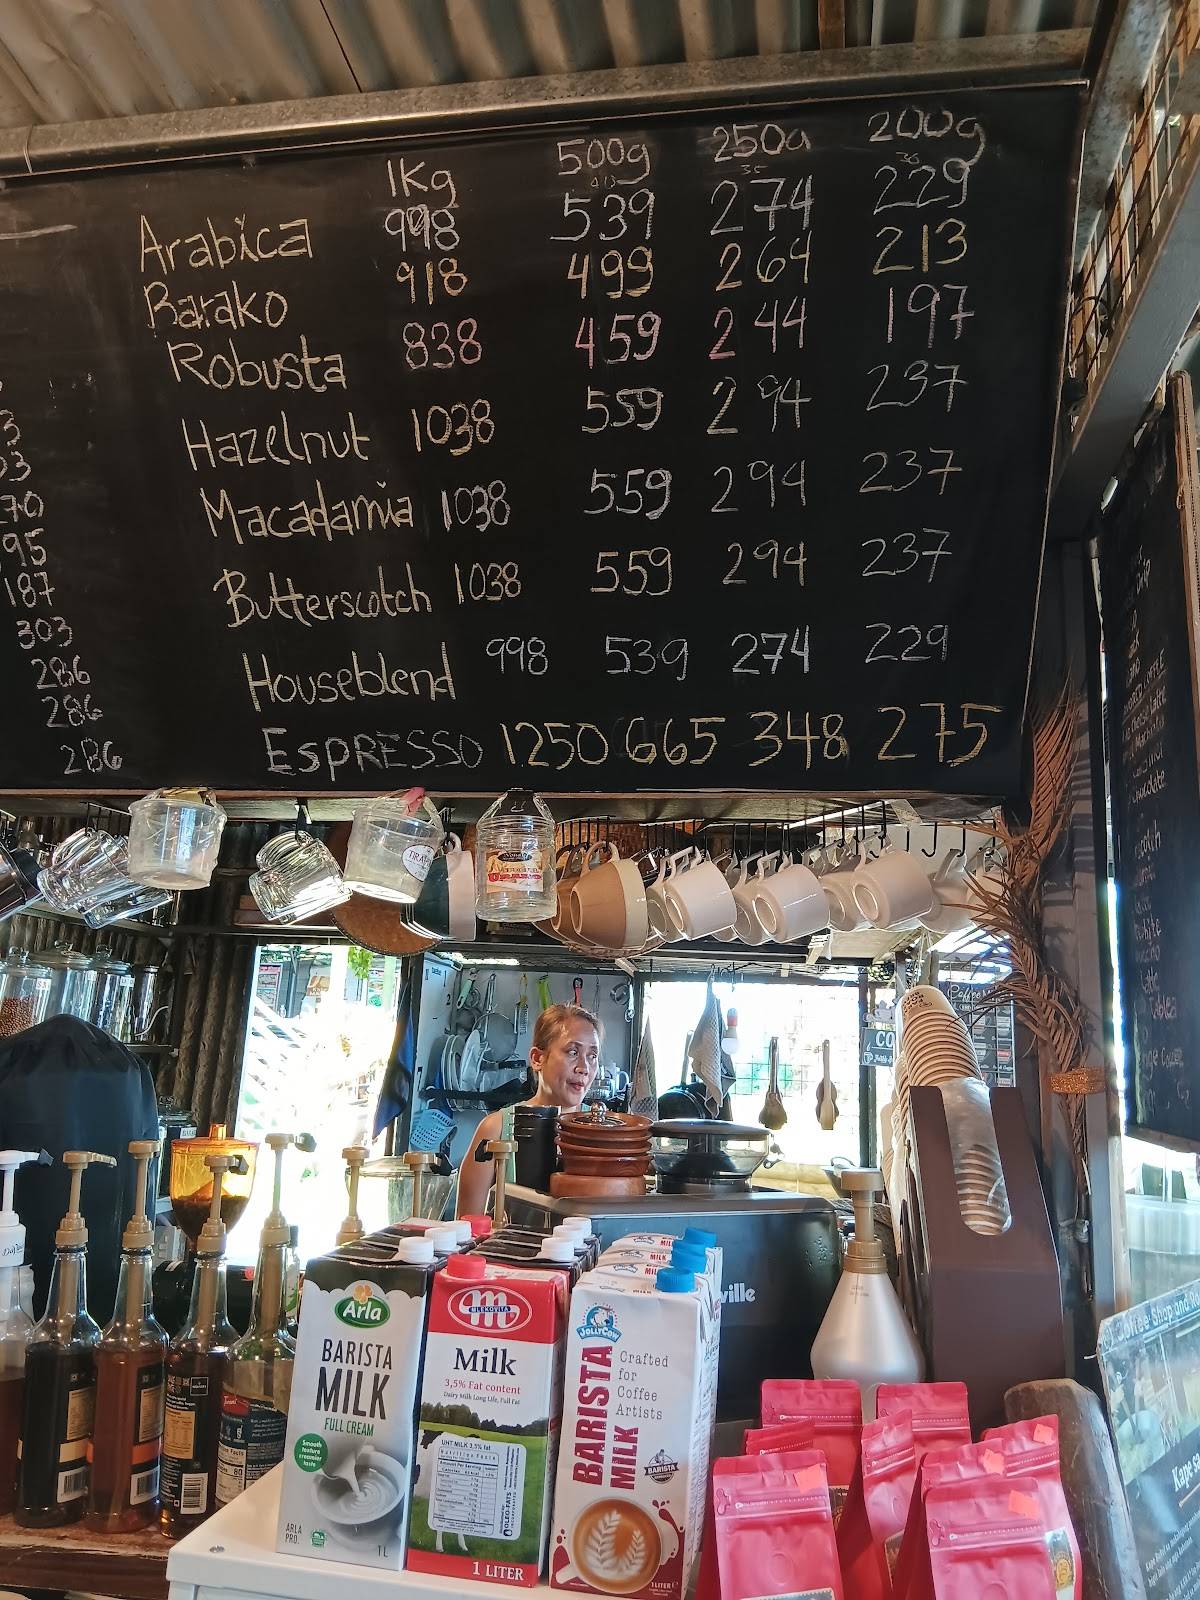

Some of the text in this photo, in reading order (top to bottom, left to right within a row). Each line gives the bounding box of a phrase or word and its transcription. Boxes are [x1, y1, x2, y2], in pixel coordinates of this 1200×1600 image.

[557, 138, 652, 185] 500g
[867, 107, 987, 166] 200g
[138, 157, 971, 275] Arabica 998 539 274 229
[142, 217, 968, 332] Barako 918 499 264 213
[166, 283, 975, 393] Robusta 838 459 244 197
[181, 359, 969, 472] Hazelnut 1038 559 294 237
[0, 490, 44, 523] 70
[199, 446, 962, 545] Macadamia 1038 559 294 237
[4, 571, 56, 608] 187
[212, 527, 953, 629] Butterscotch 1038 559 294 237
[16, 615, 73, 650] 303
[30, 654, 92, 689] 286
[242, 622, 949, 713] Houseblend 998 539 274 229
[41, 694, 104, 728] 286
[500, 720, 609, 771] 1250
[624, 715, 727, 766] 665
[748, 710, 850, 770] 348
[877, 702, 1004, 768] 275
[644, 1267, 658, 1276] MIL
[342, 1300, 382, 1321] Arla
[1151, 1304, 1173, 1326] Shop
[1174, 1294, 1190, 1316] and
[321, 1338, 392, 1370] BARISTA
[453, 1347, 517, 1376] Milk
[619, 1350, 669, 1368] Crafted
[444, 1379, 521, 1395] 3,5% Fat content
[618, 1368, 637, 1381] for
[315, 1366, 391, 1420] MILK
[443, 1391, 459, 1401] Dairy
[459, 1393, 472, 1401] Milk
[473, 1394, 487, 1403] Long
[617, 1385, 658, 1402] Coffee
[324, 1417, 375, 1437] FULL CREAM
[572, 1345, 613, 1486] BARISTA
[615, 1403, 663, 1420] Artists
[302, 1440, 322, 1448] Smooth
[610, 1425, 639, 1490] MILK
[233, 1467, 244, 1476] 80
[647, 1464, 676, 1474] BARISTA
[285, 1523, 302, 1535] ARLA
[472, 1561, 524, 1581] 1 LITER
